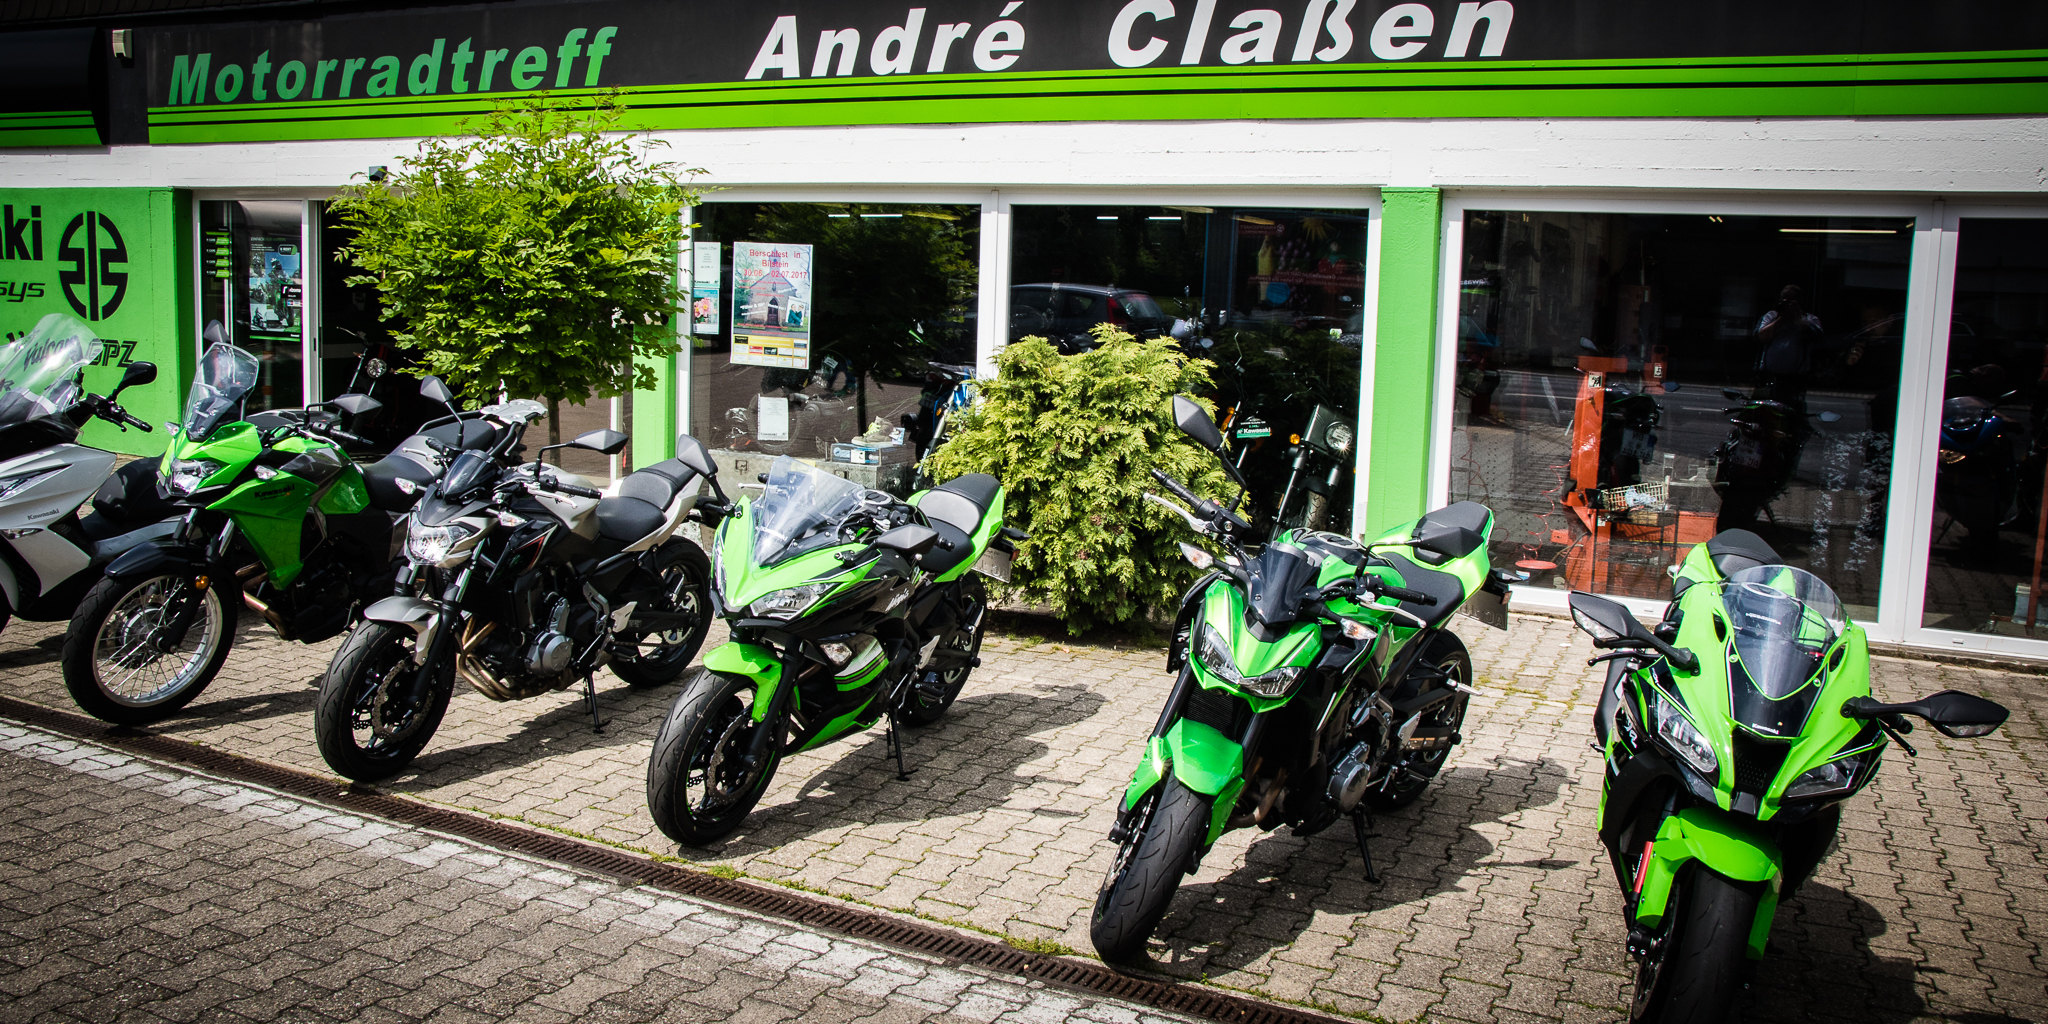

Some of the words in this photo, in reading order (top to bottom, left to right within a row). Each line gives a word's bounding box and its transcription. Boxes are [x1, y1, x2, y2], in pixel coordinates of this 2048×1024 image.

[168, 26, 618, 105] Motorradtreff
[745, 1, 1025, 80] André
[1108, 0, 1514, 68] Claßen
[0, 204, 43, 261] ki
[86, 338, 138, 368] GPZ
[27, 508, 60, 521] Kawasaki
